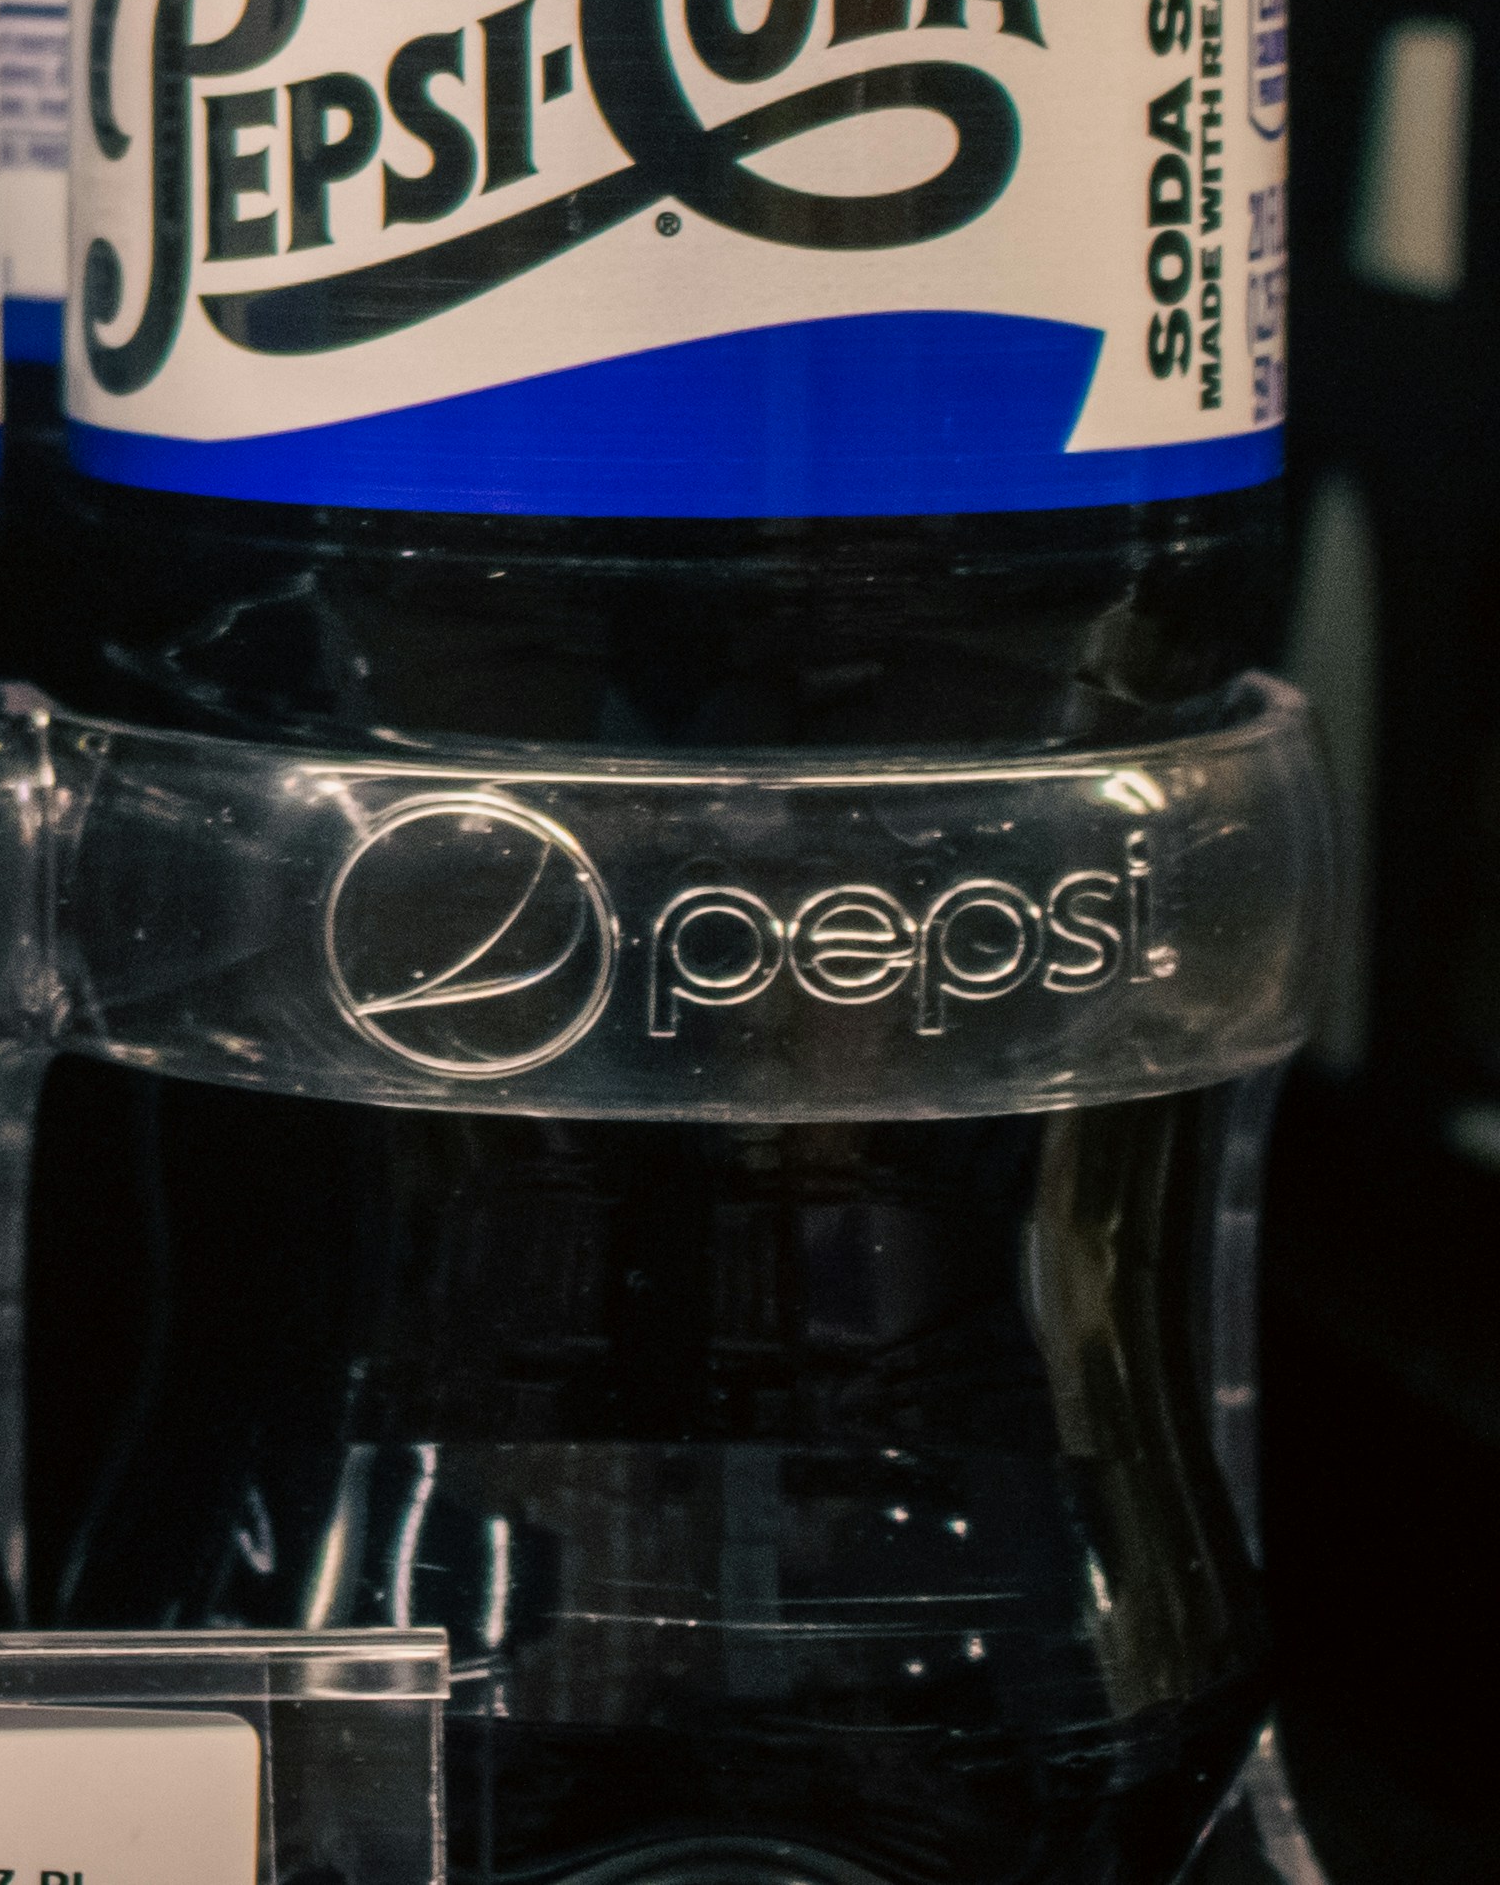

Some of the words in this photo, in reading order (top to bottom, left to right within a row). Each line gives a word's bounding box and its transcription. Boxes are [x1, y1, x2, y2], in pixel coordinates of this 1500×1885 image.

[1147, 78, 1194, 380] SODA
[1199, 89, 1223, 236] WITH
[1199, 246, 1223, 410] MADE
[648, 830, 1158, 1039] pepsi
